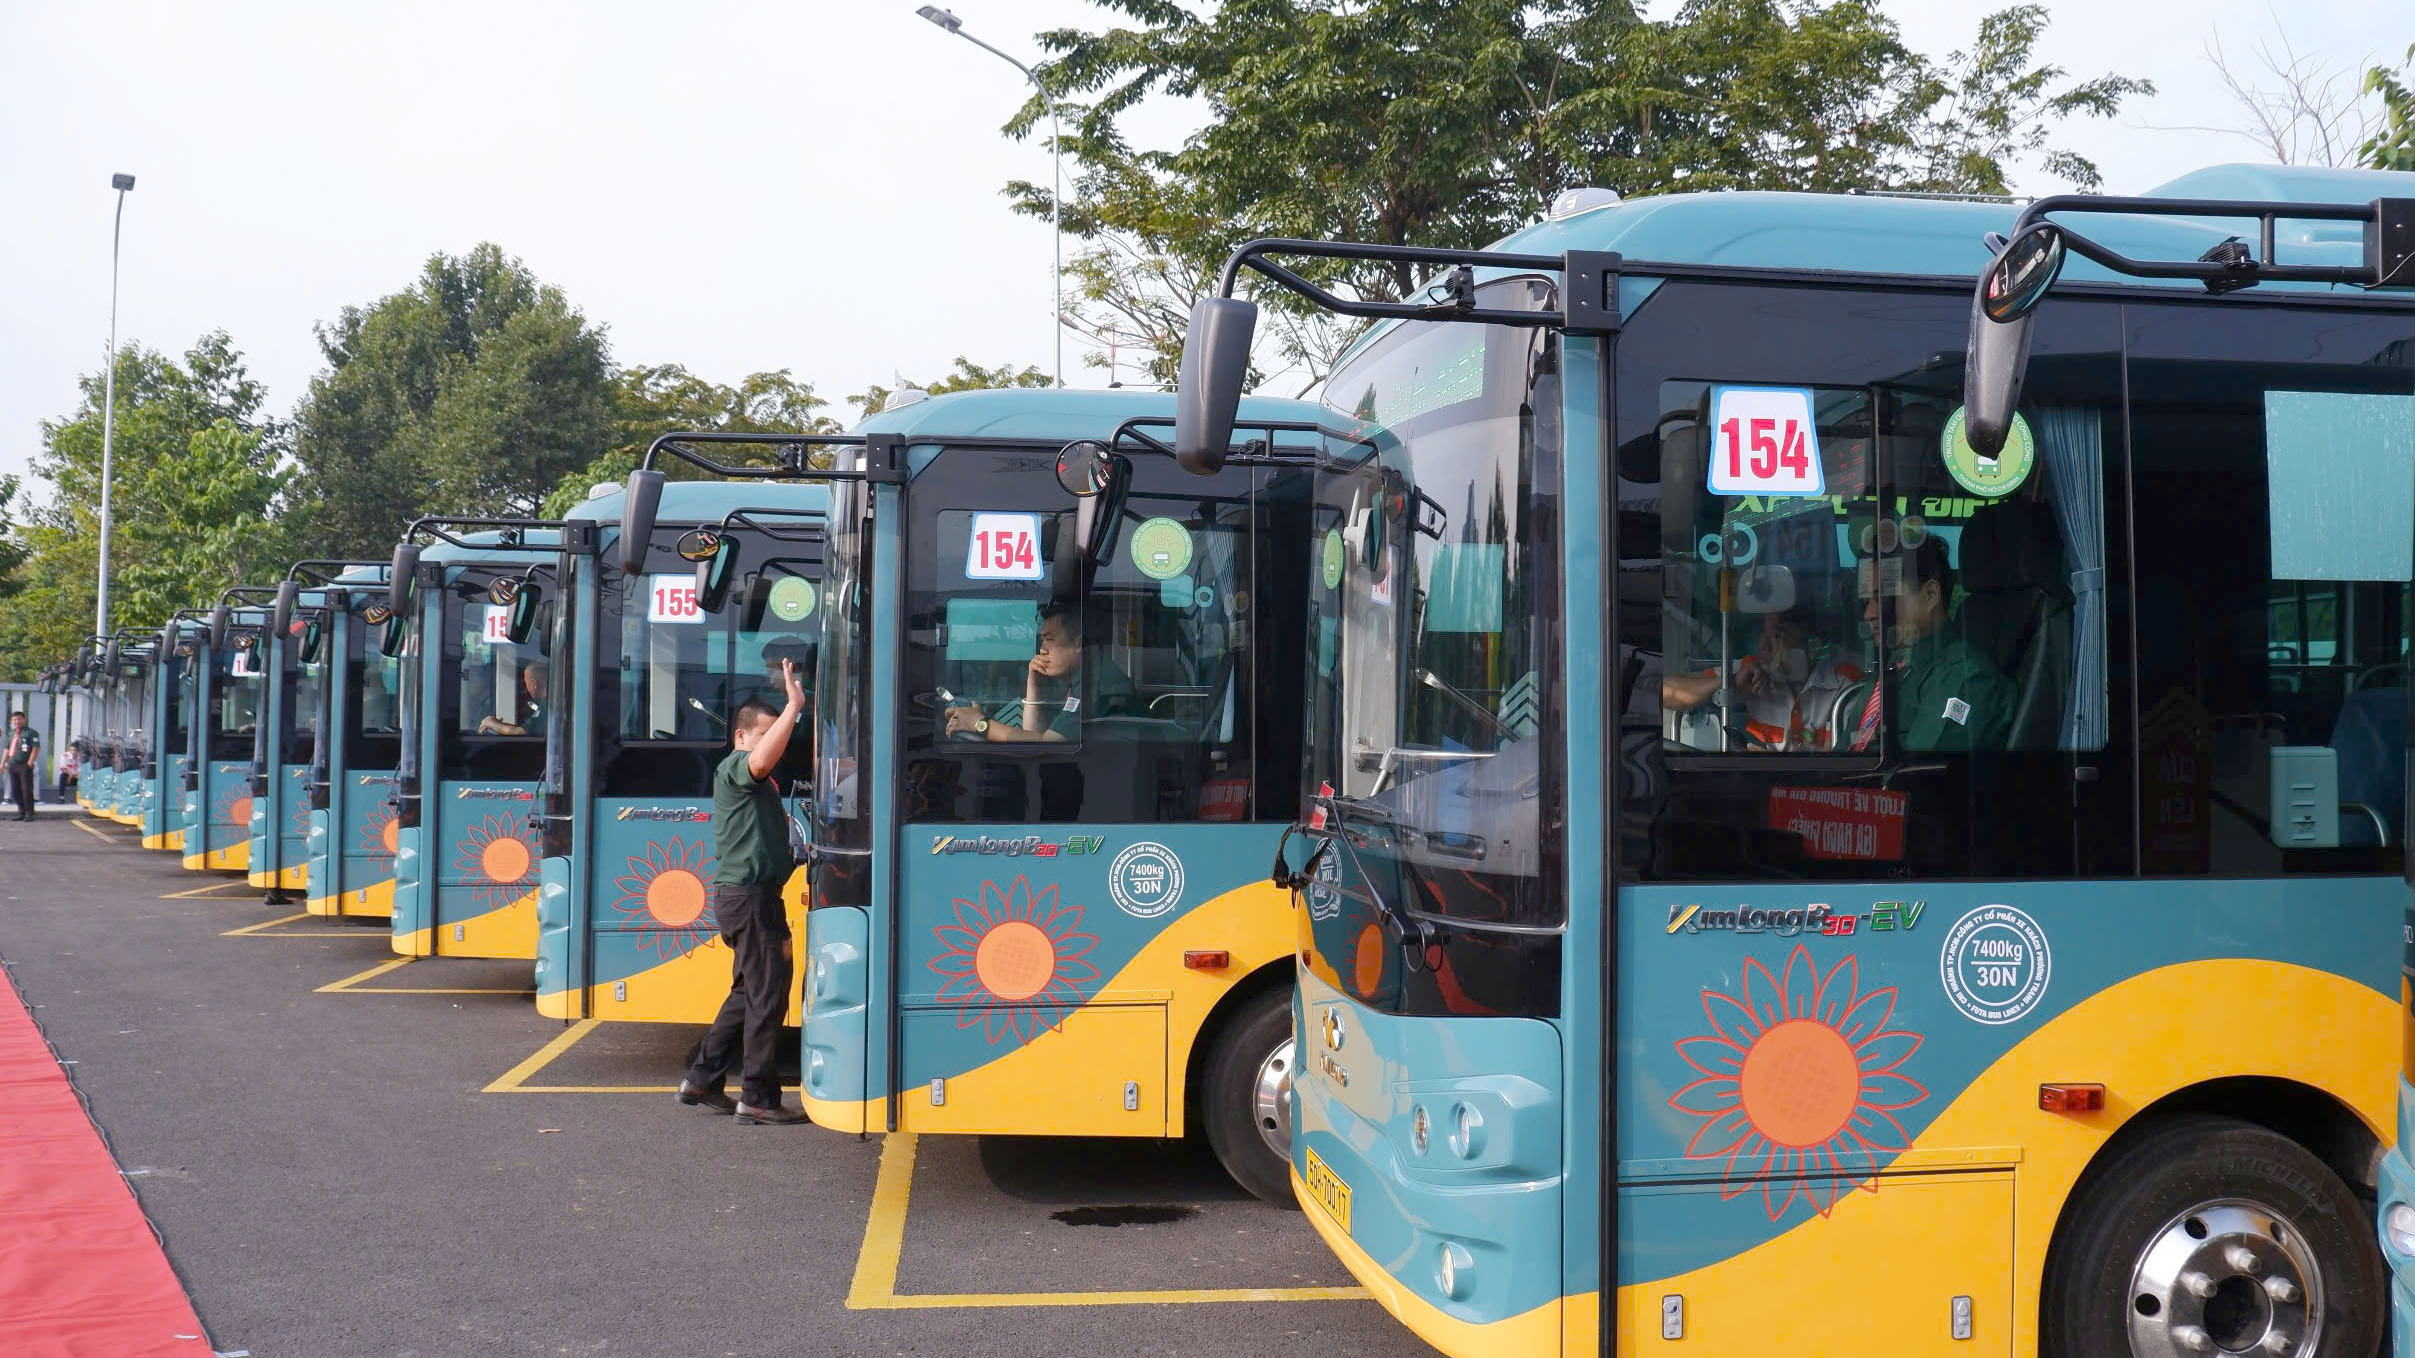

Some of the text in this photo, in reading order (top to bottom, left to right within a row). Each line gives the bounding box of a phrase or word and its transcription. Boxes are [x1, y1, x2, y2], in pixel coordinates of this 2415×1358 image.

[1721, 418, 1808, 479] 154
[976, 530, 1034, 570] 154
[655, 588, 698, 617] 155
[488, 615, 508, 638] 15
[1130, 864, 1164, 878] 7400kg
[1133, 880, 1161, 894] 30N
[1972, 915, 1983, 924] TY
[2015, 918, 2026, 929] XE
[1972, 940, 2023, 961] 7400kg
[1976, 966, 2017, 987] 30N
[1970, 1005, 1987, 1017] FUTA
